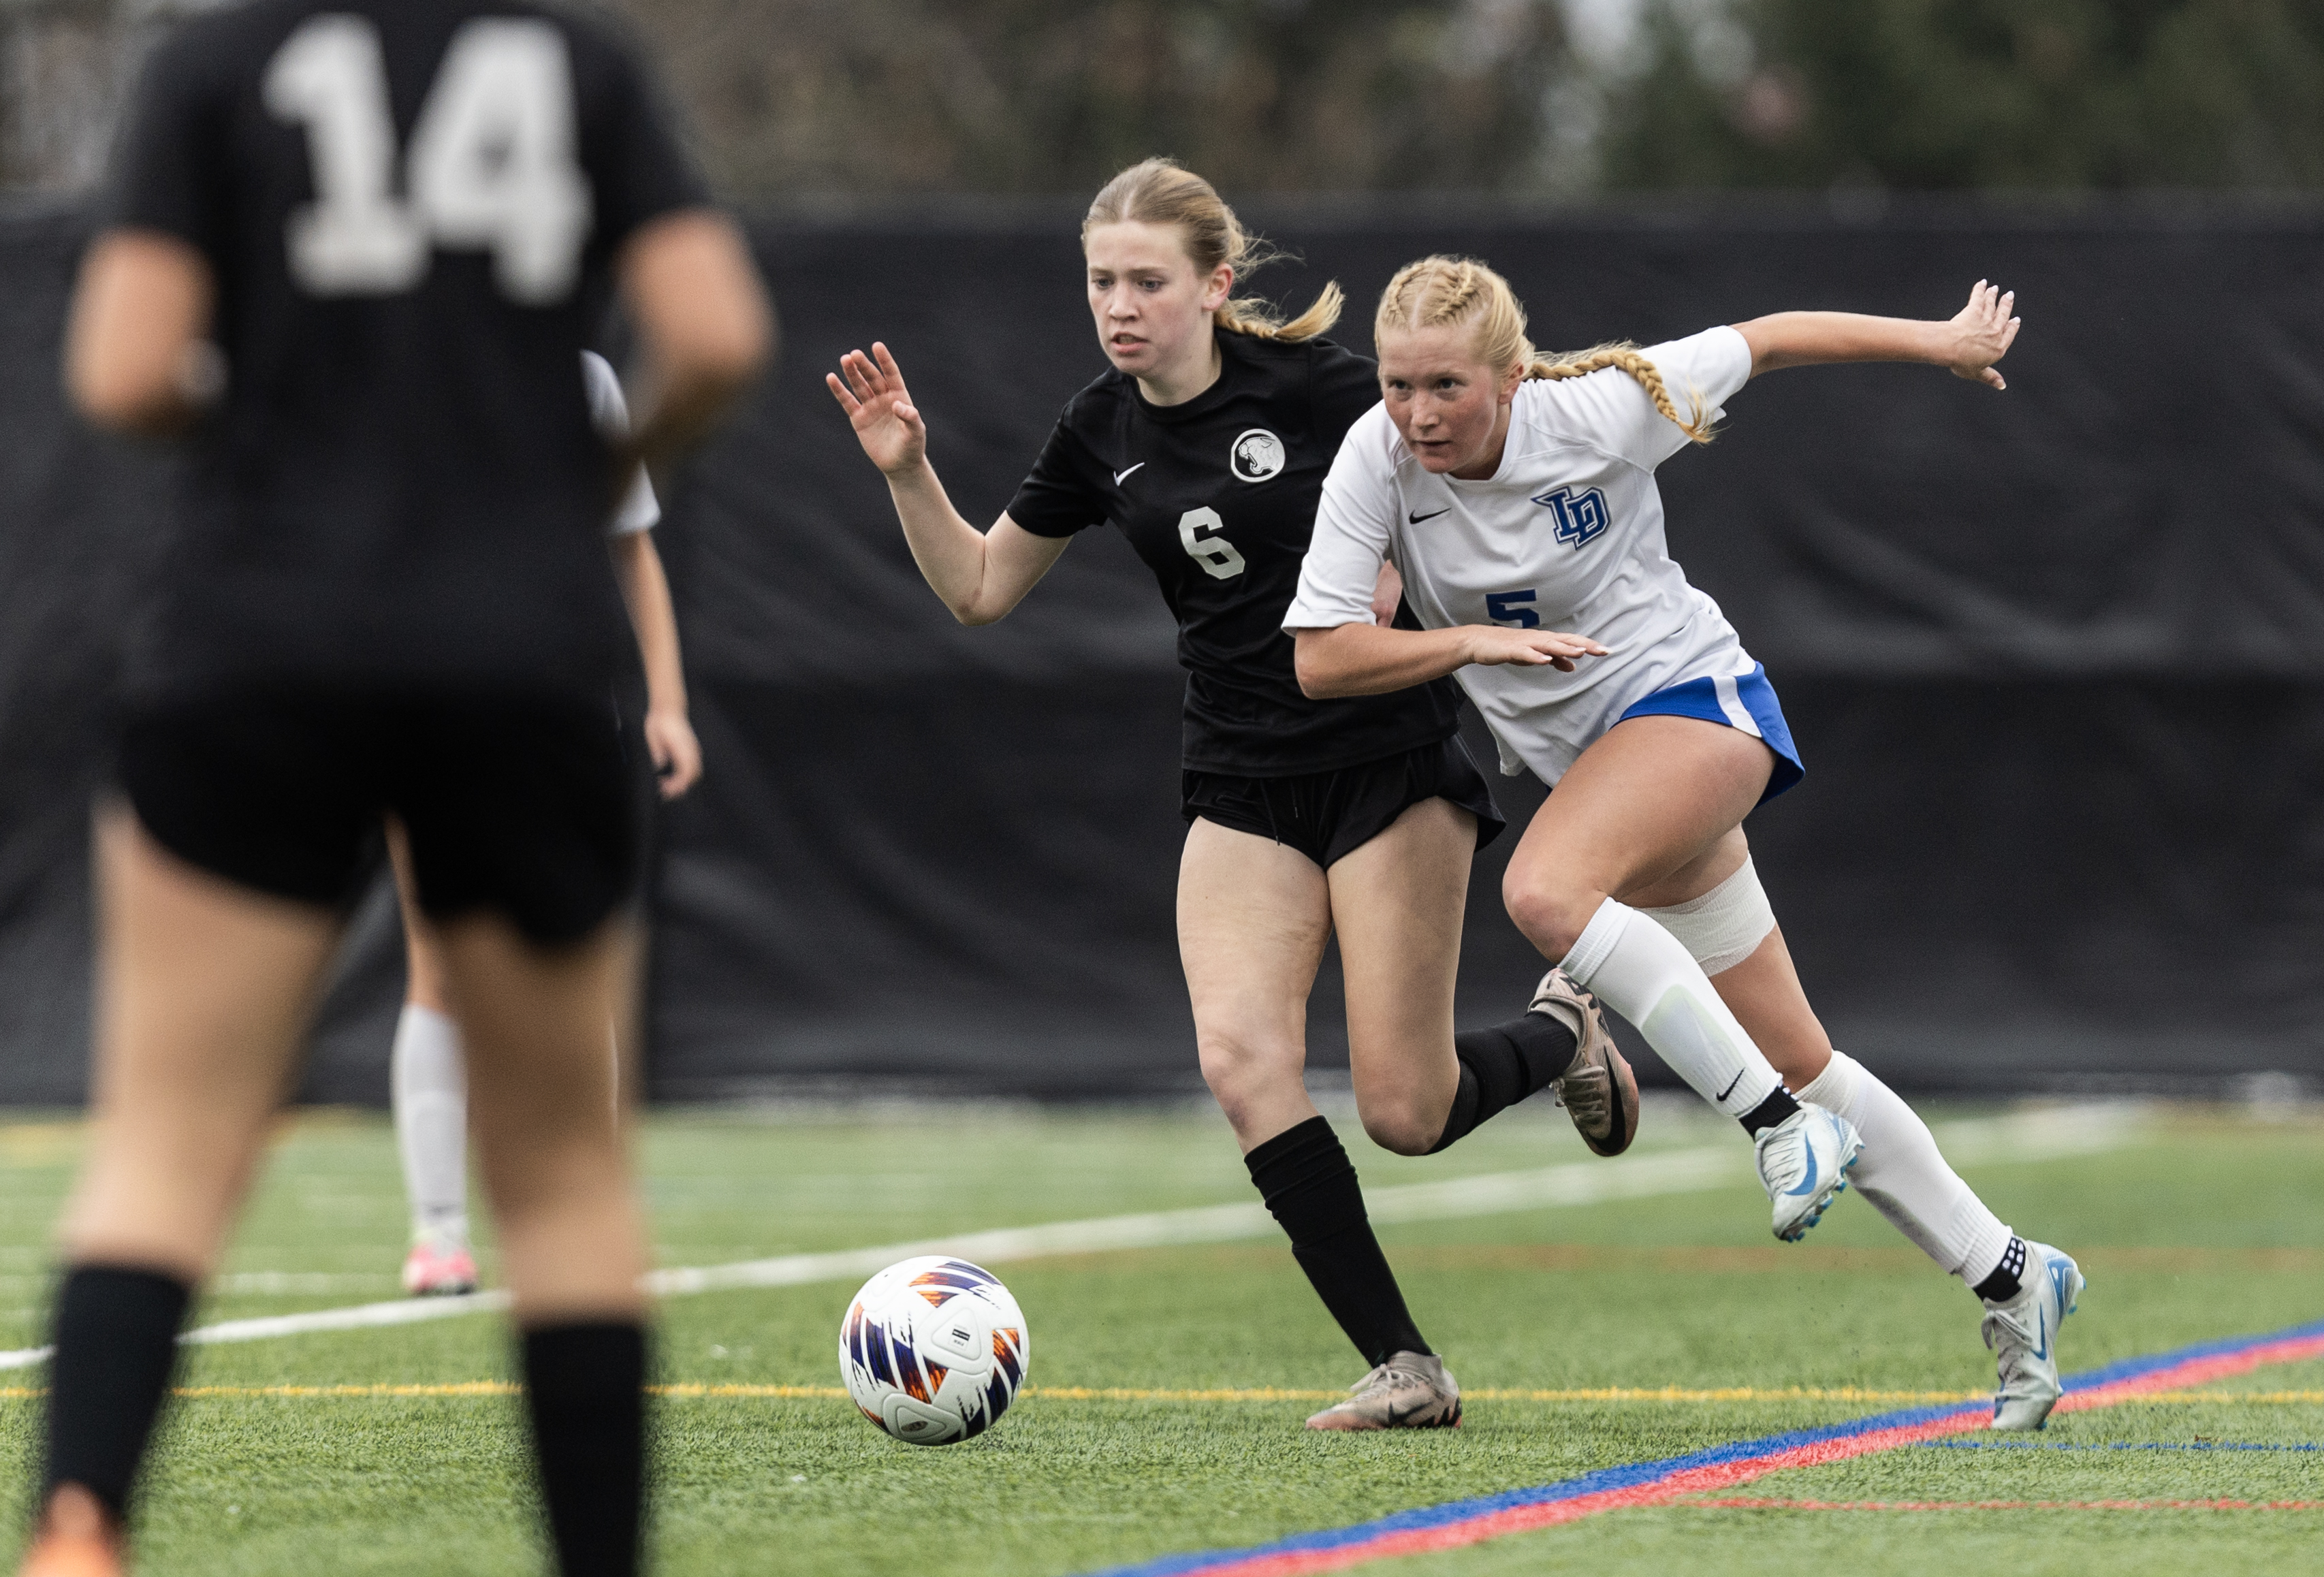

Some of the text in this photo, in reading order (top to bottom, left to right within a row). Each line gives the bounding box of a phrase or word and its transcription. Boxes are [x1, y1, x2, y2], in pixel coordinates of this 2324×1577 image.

[261, 12, 595, 306] 14
[1178, 506, 1245, 579] 6
[1530, 485, 1610, 551] LD
[1485, 589, 1540, 628] 5
